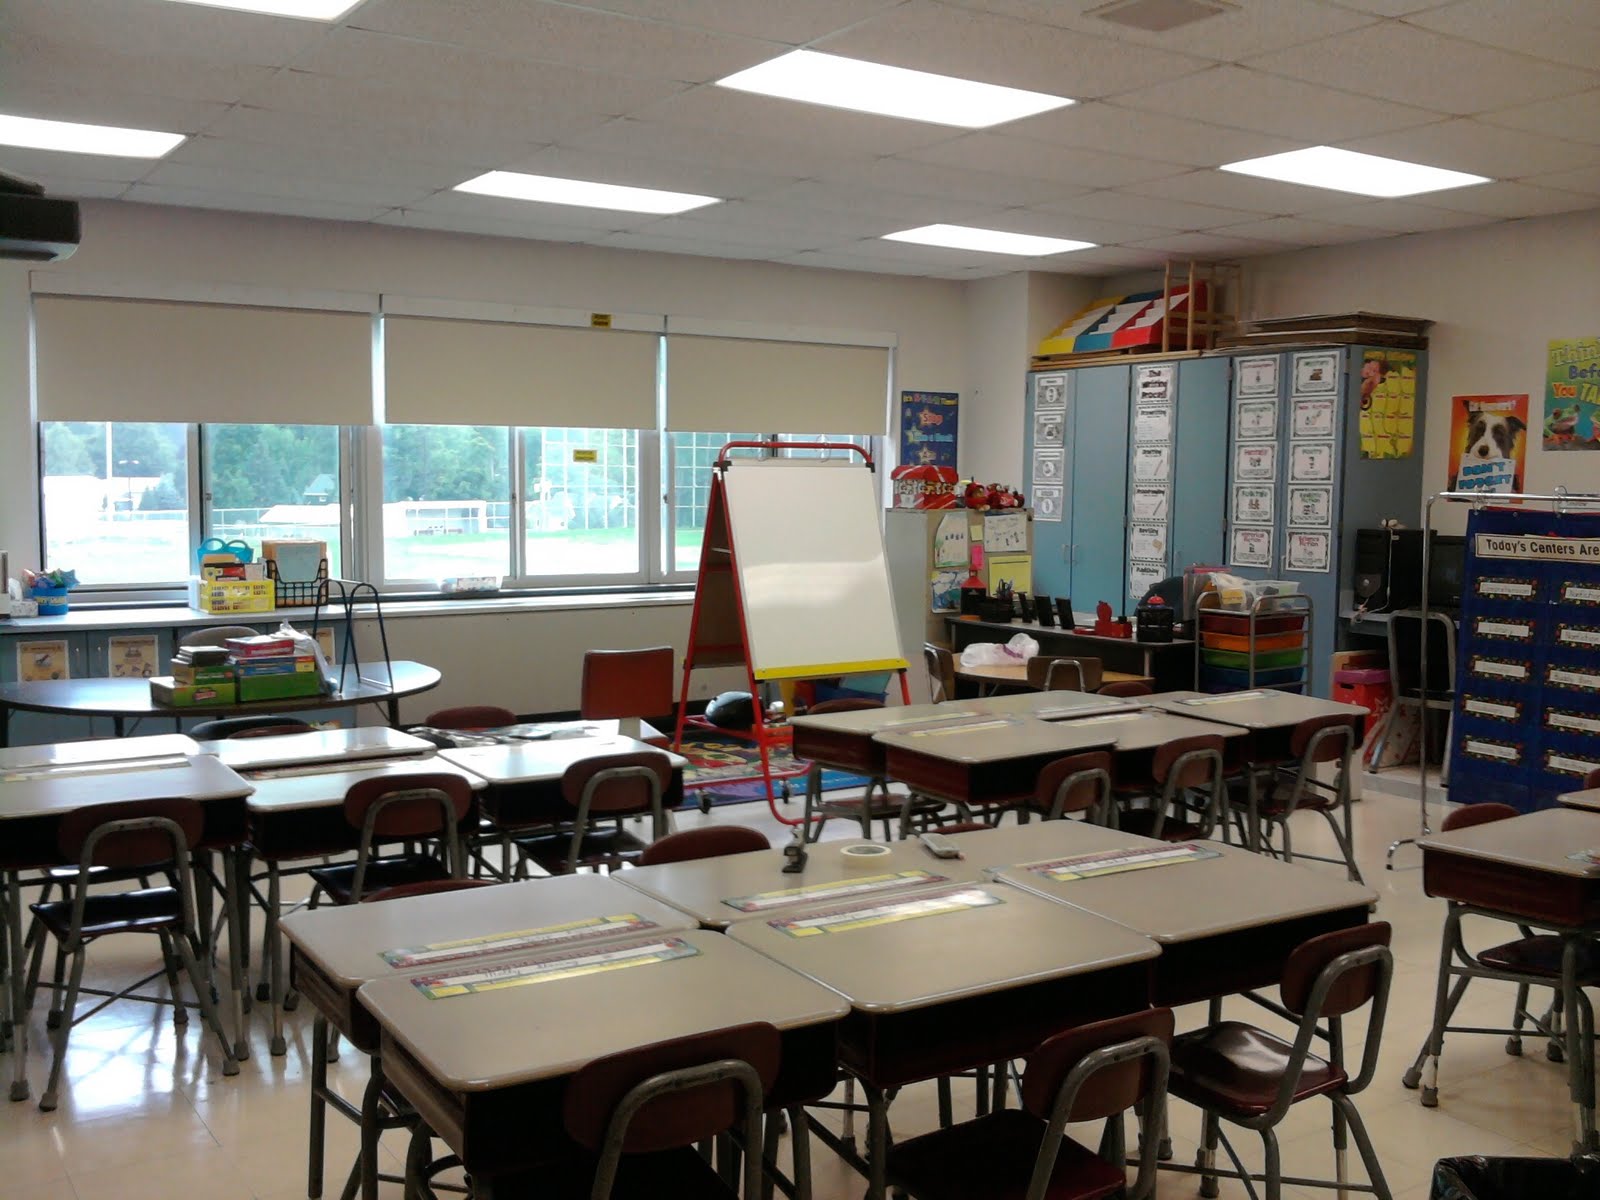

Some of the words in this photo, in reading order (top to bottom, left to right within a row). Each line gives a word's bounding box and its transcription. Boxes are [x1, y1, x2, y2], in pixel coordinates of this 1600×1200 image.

[1552, 382, 1577, 398] You
[1463, 462, 1505, 476] DON'T
[1458, 474, 1512, 489] FORGET
[1486, 539, 1527, 554] Today's
[1530, 541, 1575, 554] Centers
[1579, 544, 1600, 556] Are
